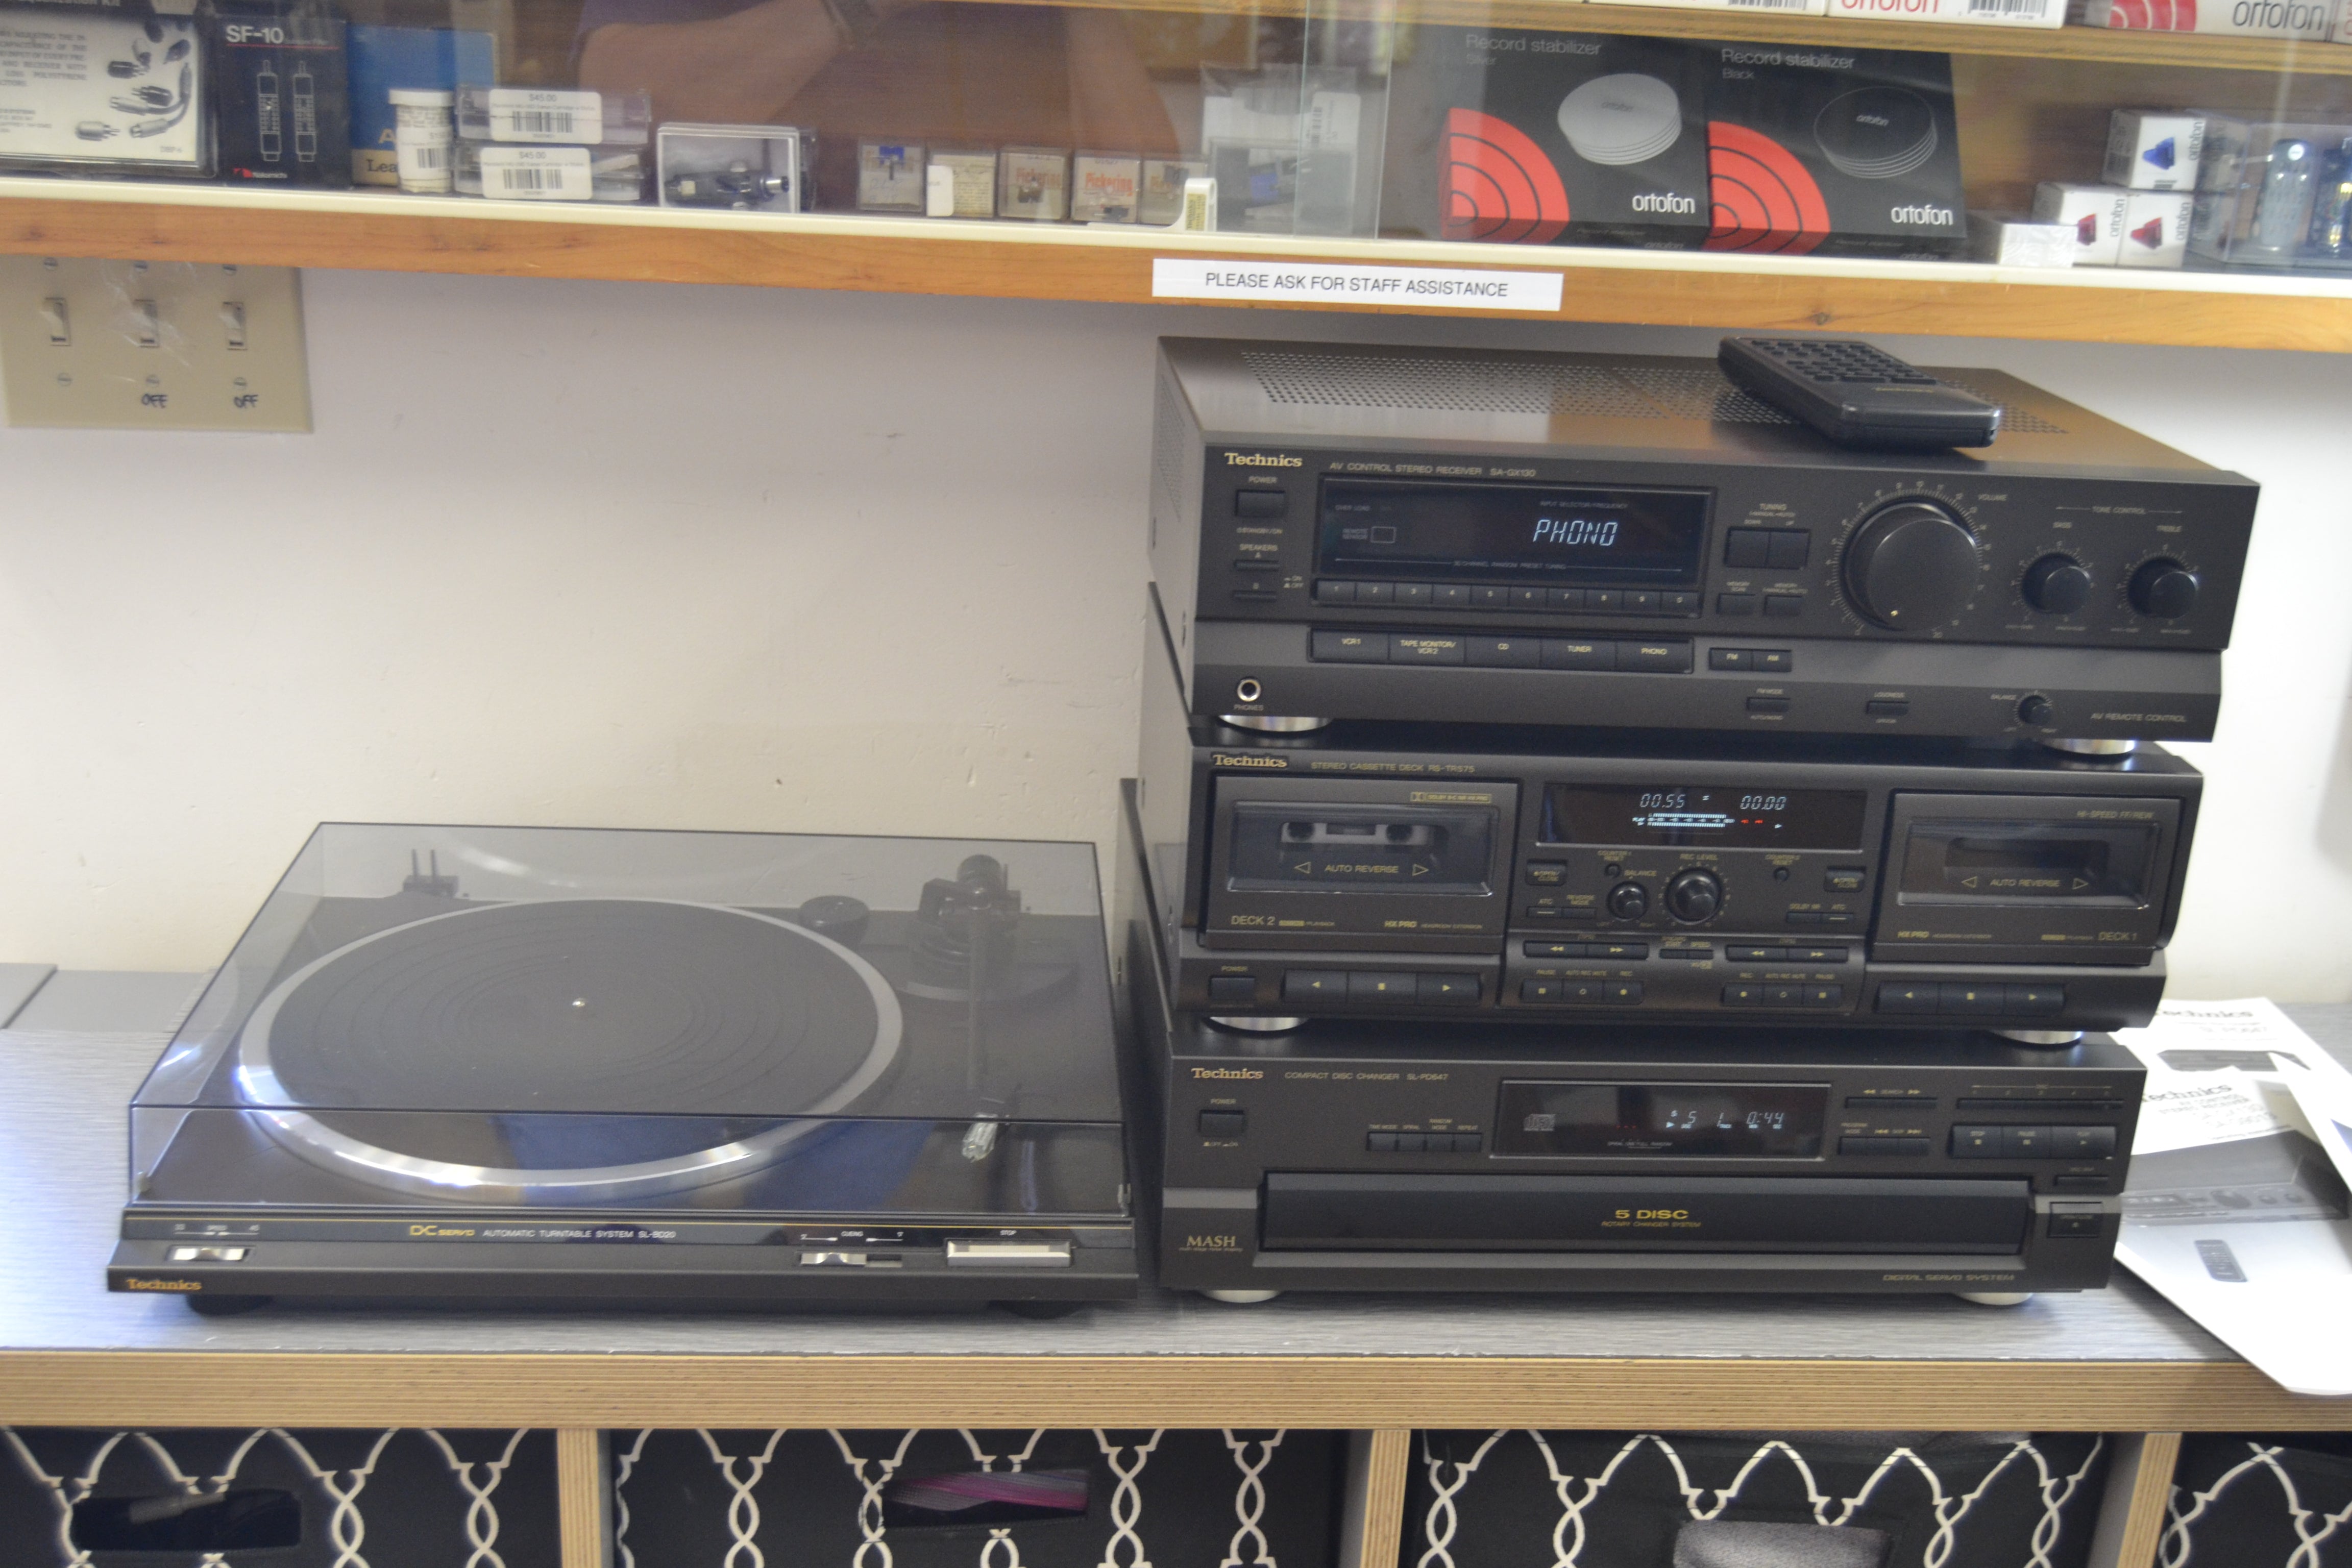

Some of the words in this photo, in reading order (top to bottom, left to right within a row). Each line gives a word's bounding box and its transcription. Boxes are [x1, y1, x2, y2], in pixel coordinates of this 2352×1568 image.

[2232, 0, 2325, 31] ortofon
[226, 25, 284, 44] SF-10
[1466, 35, 1525, 51] Record
[1531, 37, 1602, 55] stabilizer
[1722, 49, 1781, 66] Record
[1786, 51, 1856, 68] stabilizer
[1722, 68, 1755, 80] Black
[2188, 121, 2203, 161] ortofon
[1086, 171, 1133, 193] Pickering
[1632, 192, 1696, 214] ortofon
[1891, 205, 1953, 226] ortofon
[2110, 198, 2126, 237] ortofon
[2176, 202, 2191, 241] ortofon
[1206, 273, 1270, 289] PLEASE
[1273, 275, 1307, 290] ASK
[1311, 276, 1345, 292] FOR
[1349, 277, 1402, 293] STAFF
[1405, 279, 1508, 298] ASSISTANCE
[141, 393, 168, 408] OFF
[234, 394, 259, 408] OFF
[1224, 453, 1303, 468] Technics
[1330, 462, 1343, 471] AV
[1347, 463, 1392, 472] CONTROL
[1395, 464, 1433, 474] STEREO
[1436, 466, 1483, 475] RECEIVER
[1248, 476, 1278, 484] POWER
[2113, 506, 2146, 514] CONTROL
[1533, 519, 1619, 546] PHONO
[1419, 640, 1457, 649] MONITOR/
[1567, 645, 1592, 653] TUNER
[1641, 647, 1668, 655] PHONO
[1213, 754, 1287, 768] Technics
[1311, 762, 1348, 771] STEREO
[1349, 763, 1396, 772] CASSETTE
[1399, 764, 1424, 772] DECK
[1639, 793, 1686, 808] 00.55
[1740, 795, 1786, 810] 00.00
[2077, 810, 2117, 819] HI-SPEED
[1325, 864, 1352, 873] AUTO
[1354, 865, 1399, 874] REVERSE
[1990, 879, 2016, 887] AUTO
[2018, 879, 2061, 888] REVERSE
[1231, 916, 1264, 925] DECK
[1266, 916, 1276, 925] 2
[2098, 932, 2129, 941] DECK
[2132, 932, 2138, 941] 1
[2156, 1009, 2253, 1018] echnics
[1191, 1067, 1264, 1080] Technics
[1284, 1071, 1329, 1080] COMPACT
[1332, 1072, 1353, 1080] DISC
[1356, 1072, 1400, 1081] CHANGER
[1746, 1111, 1784, 1124] 0:44
[1615, 1210, 1630, 1219] 5
[1636, 1210, 1688, 1220] DISC
[409, 1225, 438, 1236] DC
[482, 1230, 536, 1238] AUTOMATIC
[1187, 1235, 1236, 1247] MASH
[127, 1279, 202, 1291] Technics
